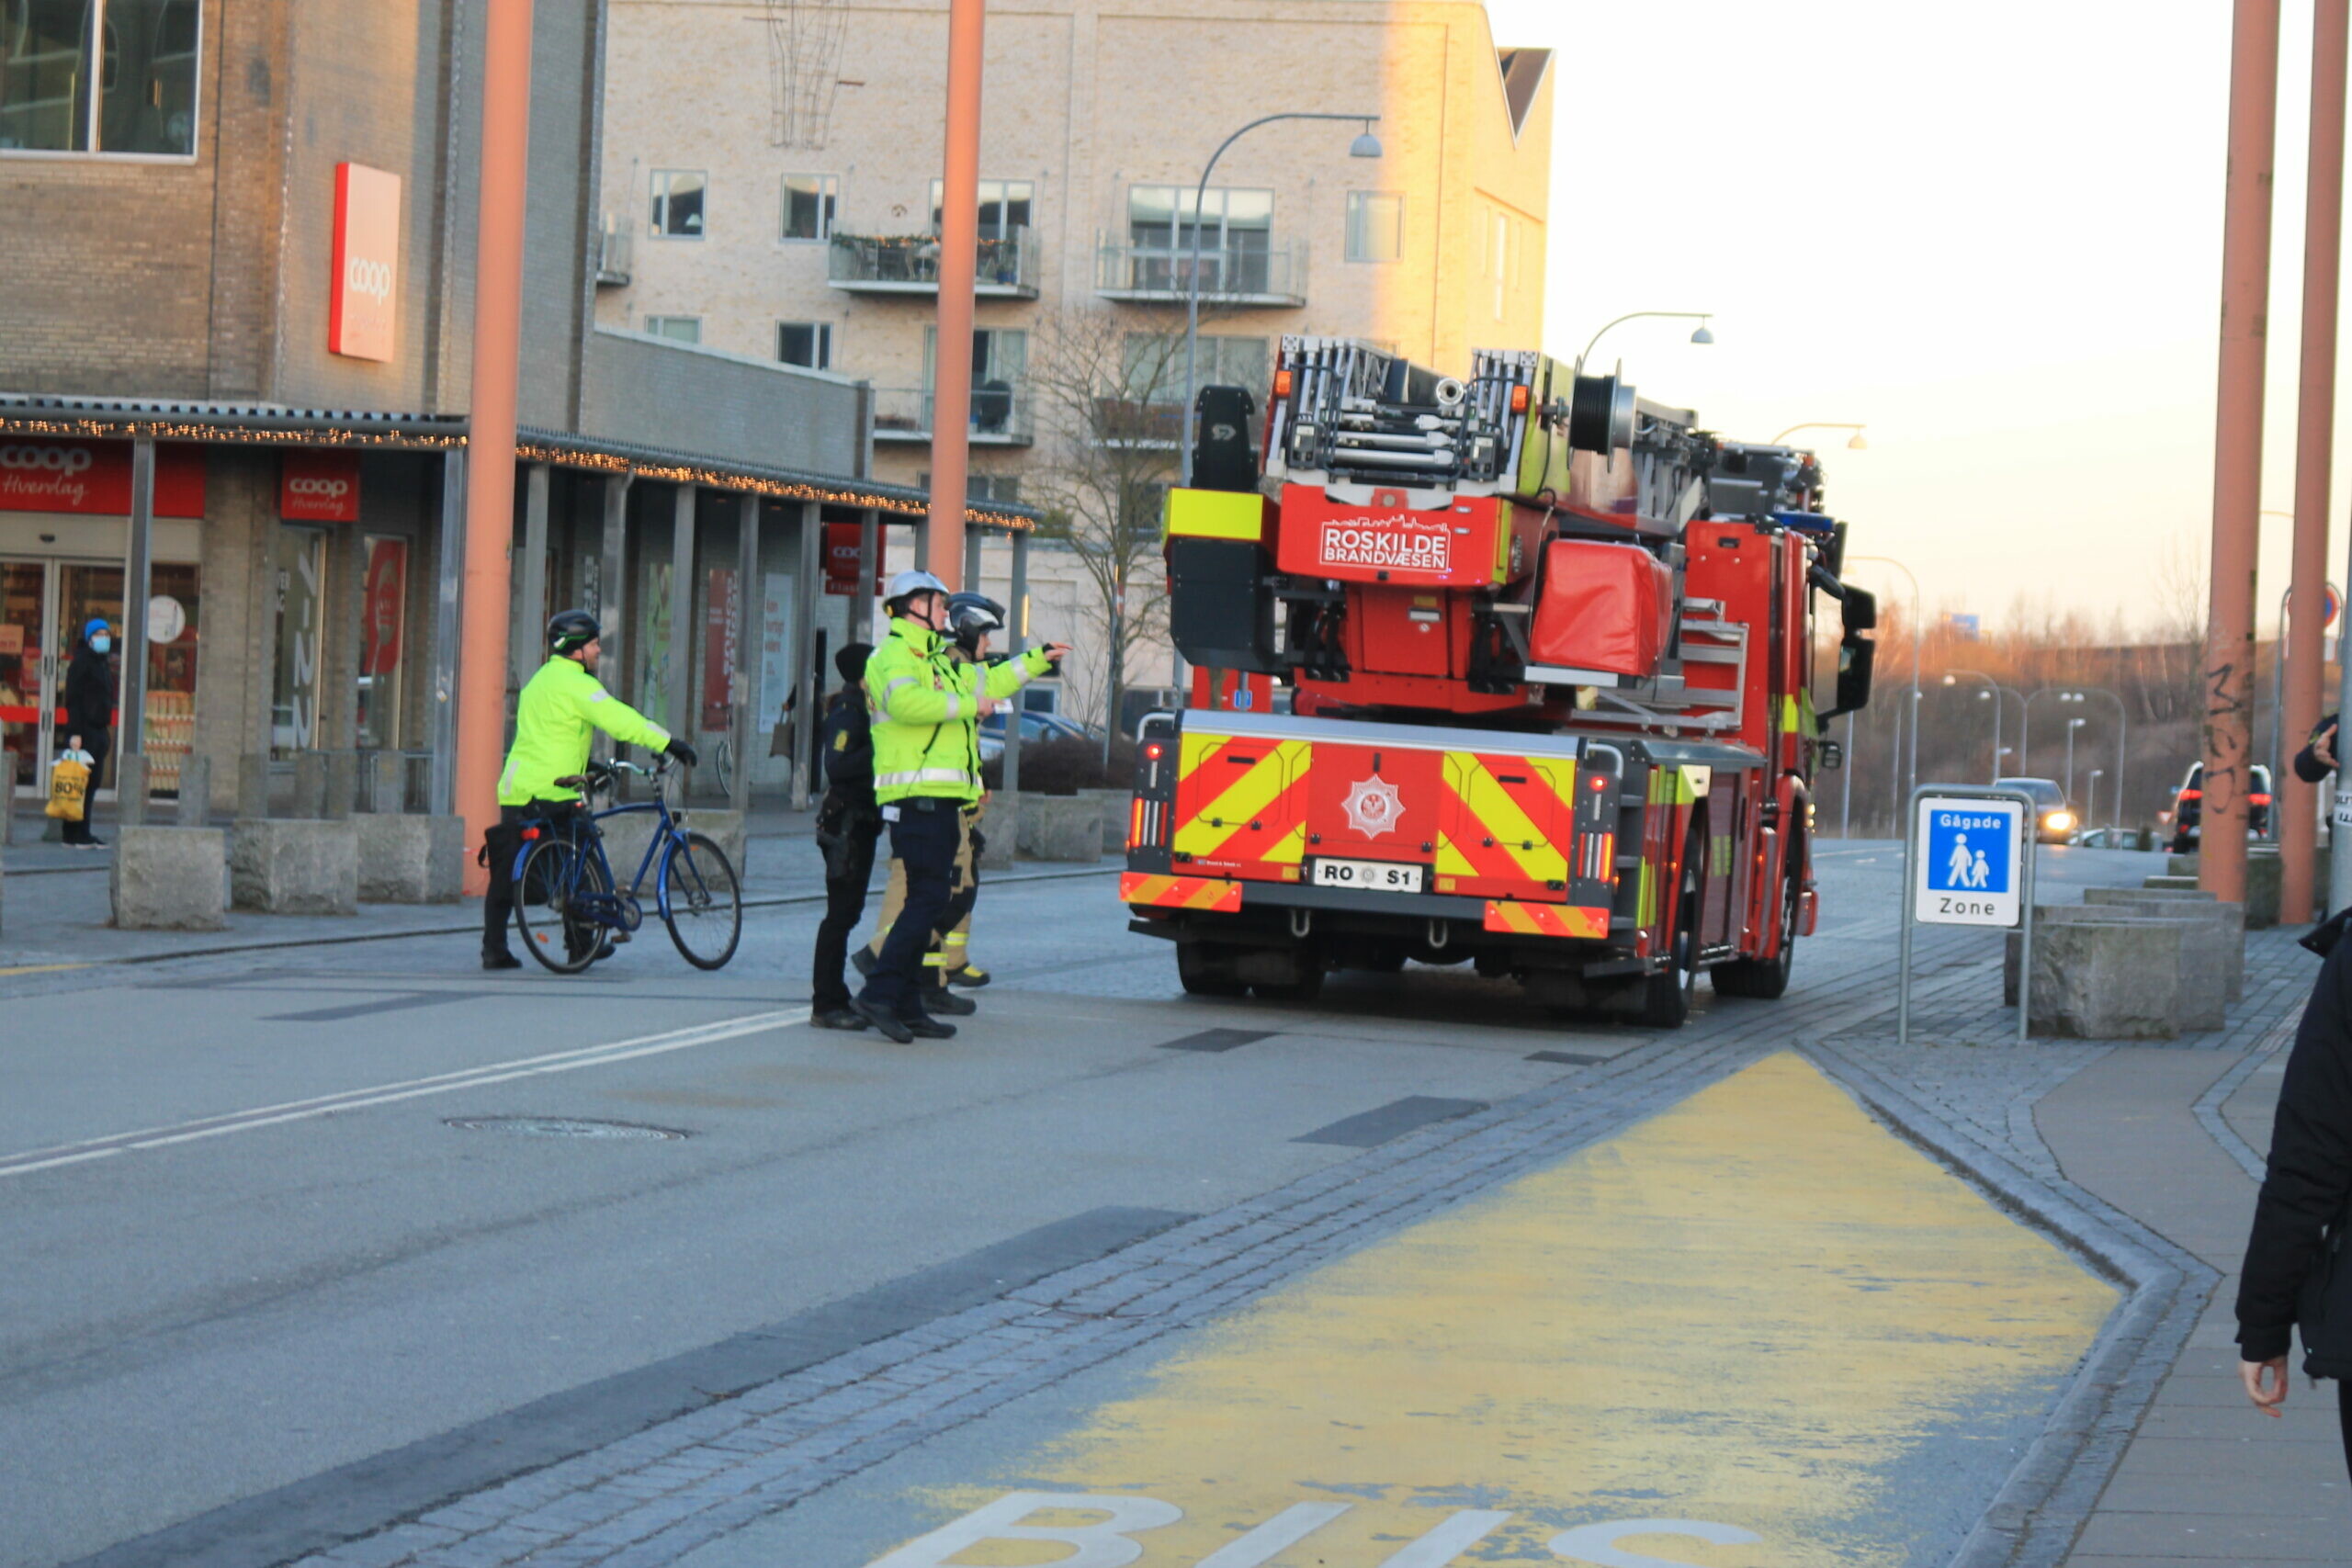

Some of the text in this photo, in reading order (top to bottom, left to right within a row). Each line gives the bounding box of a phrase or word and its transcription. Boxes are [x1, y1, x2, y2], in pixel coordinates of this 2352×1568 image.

[350, 256, 391, 306] coop
[0, 445, 92, 476] coop
[3, 472, 88, 504] Hverdag
[289, 479, 348, 498] coop
[1325, 528, 1446, 556] ROSKILDE
[1324, 548, 1445, 569] BRANDVÆSEN
[1939, 814, 2001, 829] Gågade
[1324, 865, 1410, 885] RO S1
[1939, 897, 1995, 916] Zone
